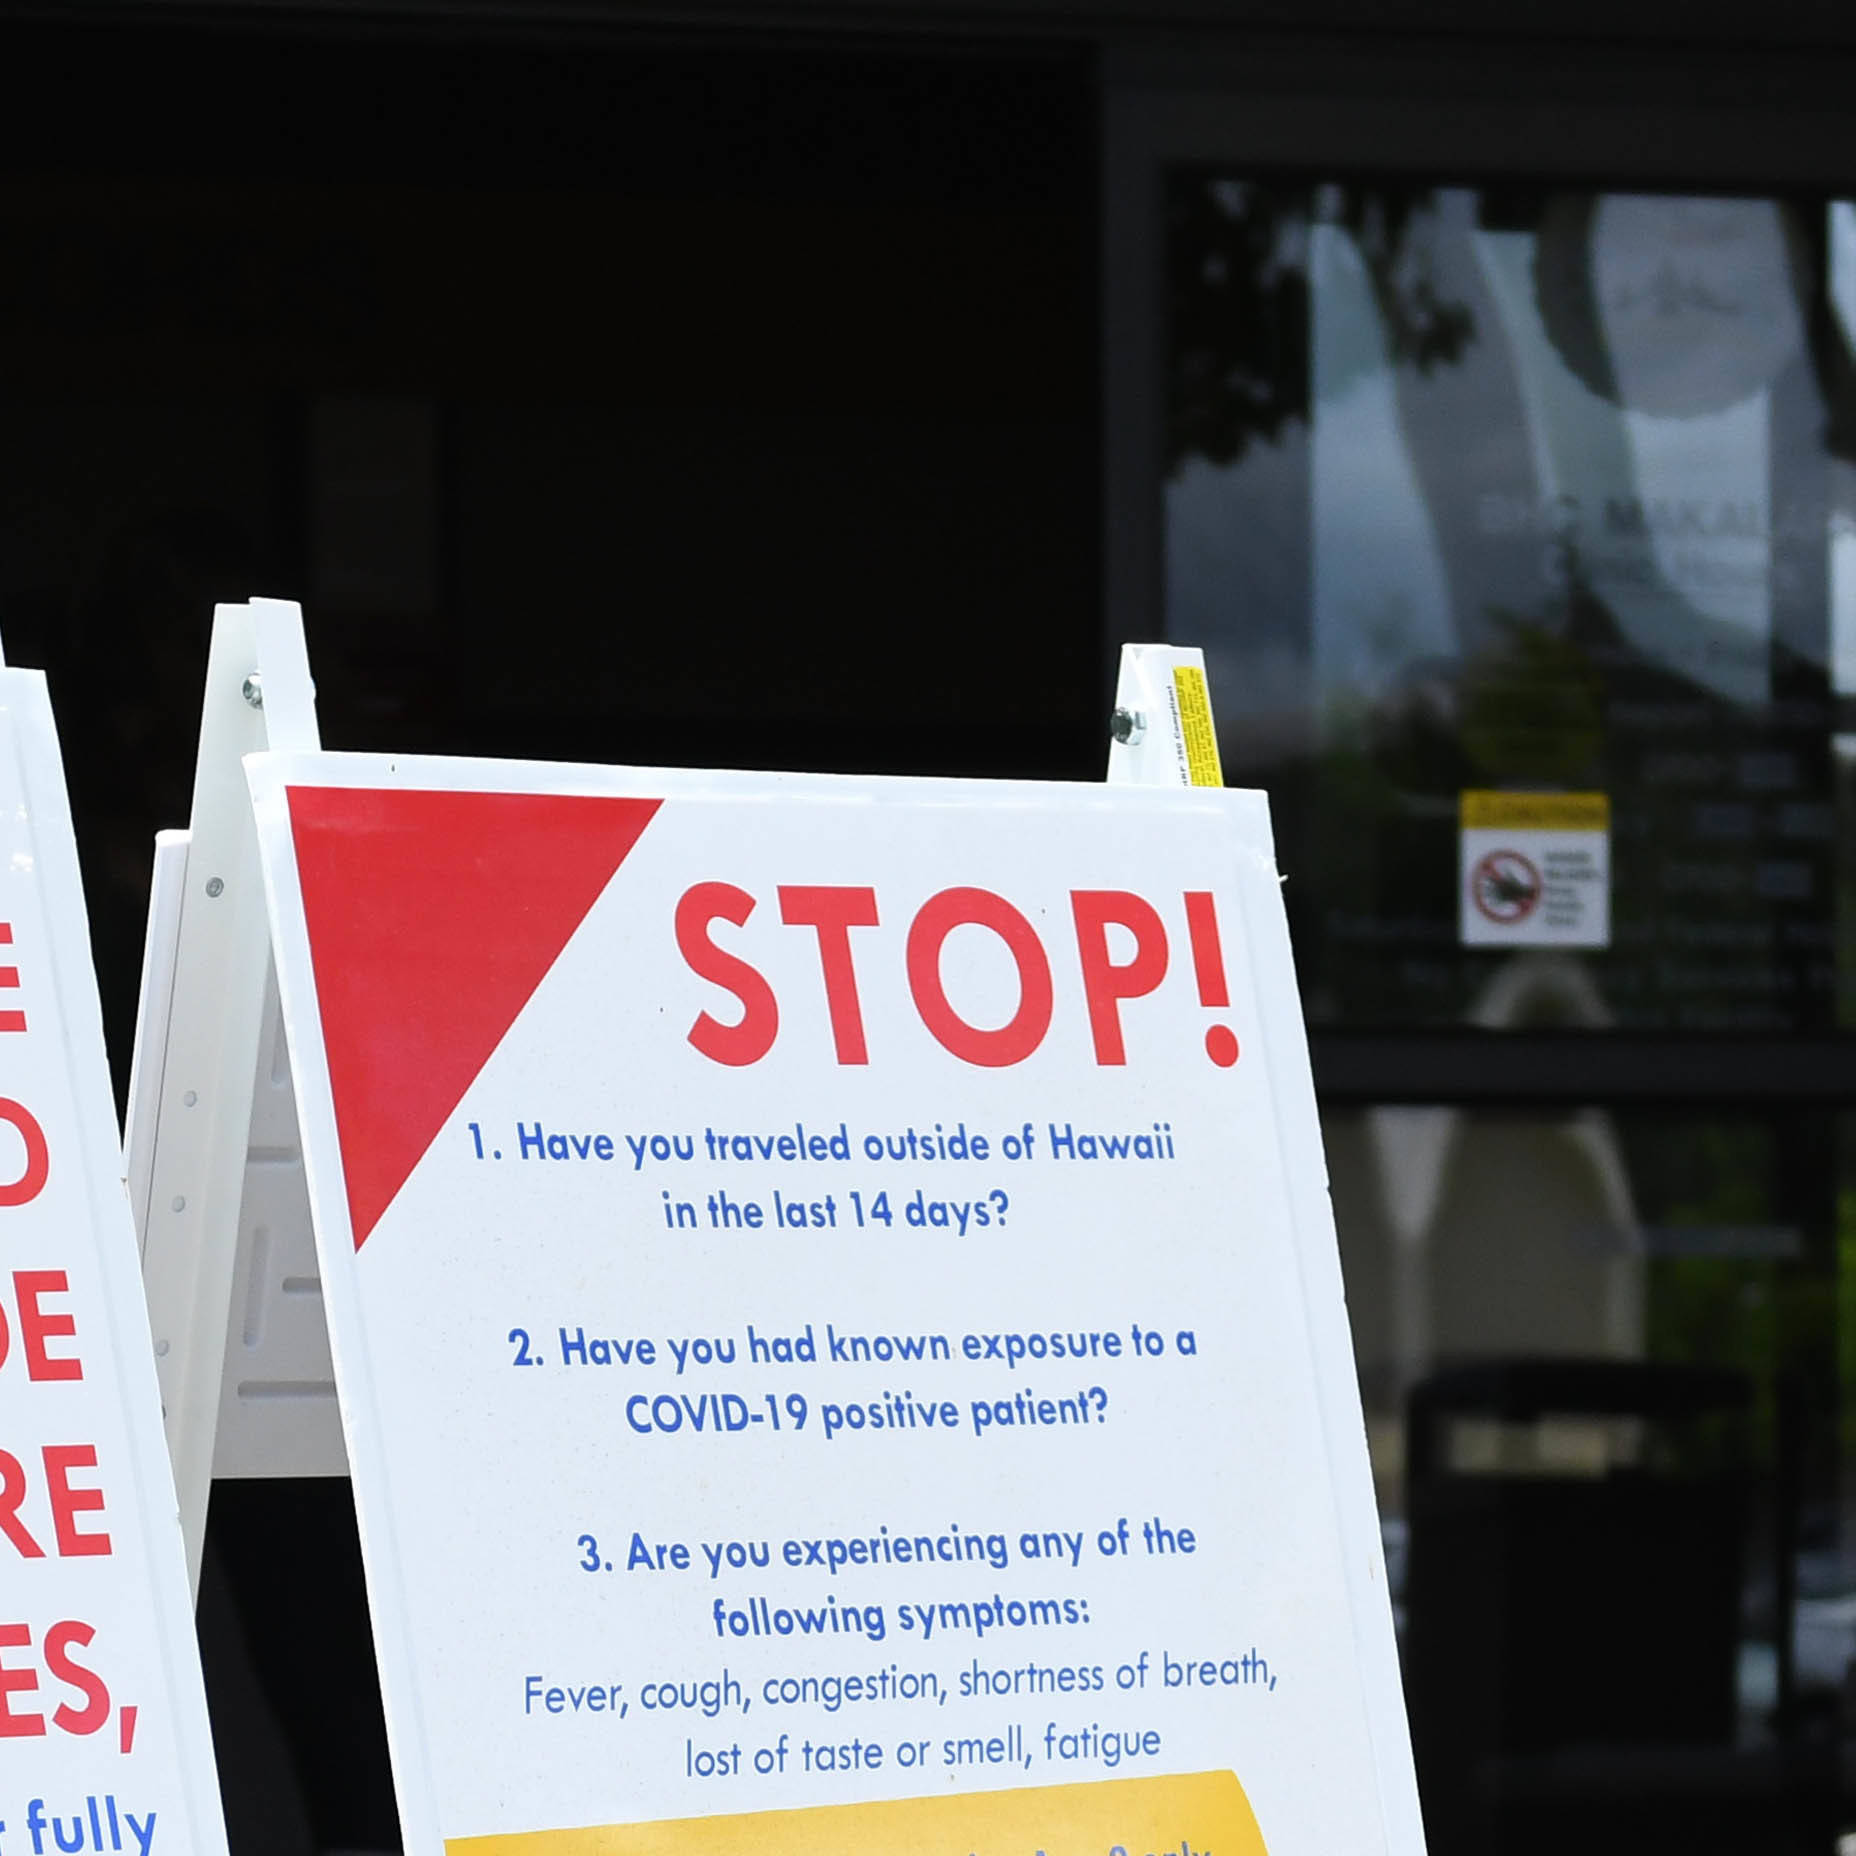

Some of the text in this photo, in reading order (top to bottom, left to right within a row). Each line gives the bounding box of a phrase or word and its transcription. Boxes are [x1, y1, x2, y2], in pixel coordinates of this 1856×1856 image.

[1166, 685, 1182, 739] Compliant
[676, 882, 1239, 1067] STOP!
[468, 1122, 1174, 1170] 1. Have you traveled outside of Hawaii
[662, 1189, 1008, 1236] in the last 14 days?
[509, 1324, 1197, 1374] 2. Have you had known exposure to a
[626, 1386, 1108, 1440] COVID-19 positive patient?
[578, 1517, 1195, 1579] 3. Are you experiencing any of the
[714, 1595, 1089, 1640] following symptoms:
[526, 1648, 1277, 1719] Fever, cough, congestion, shortness of breath,
[688, 1722, 1160, 1776] lost of taste or smell, fatigue
